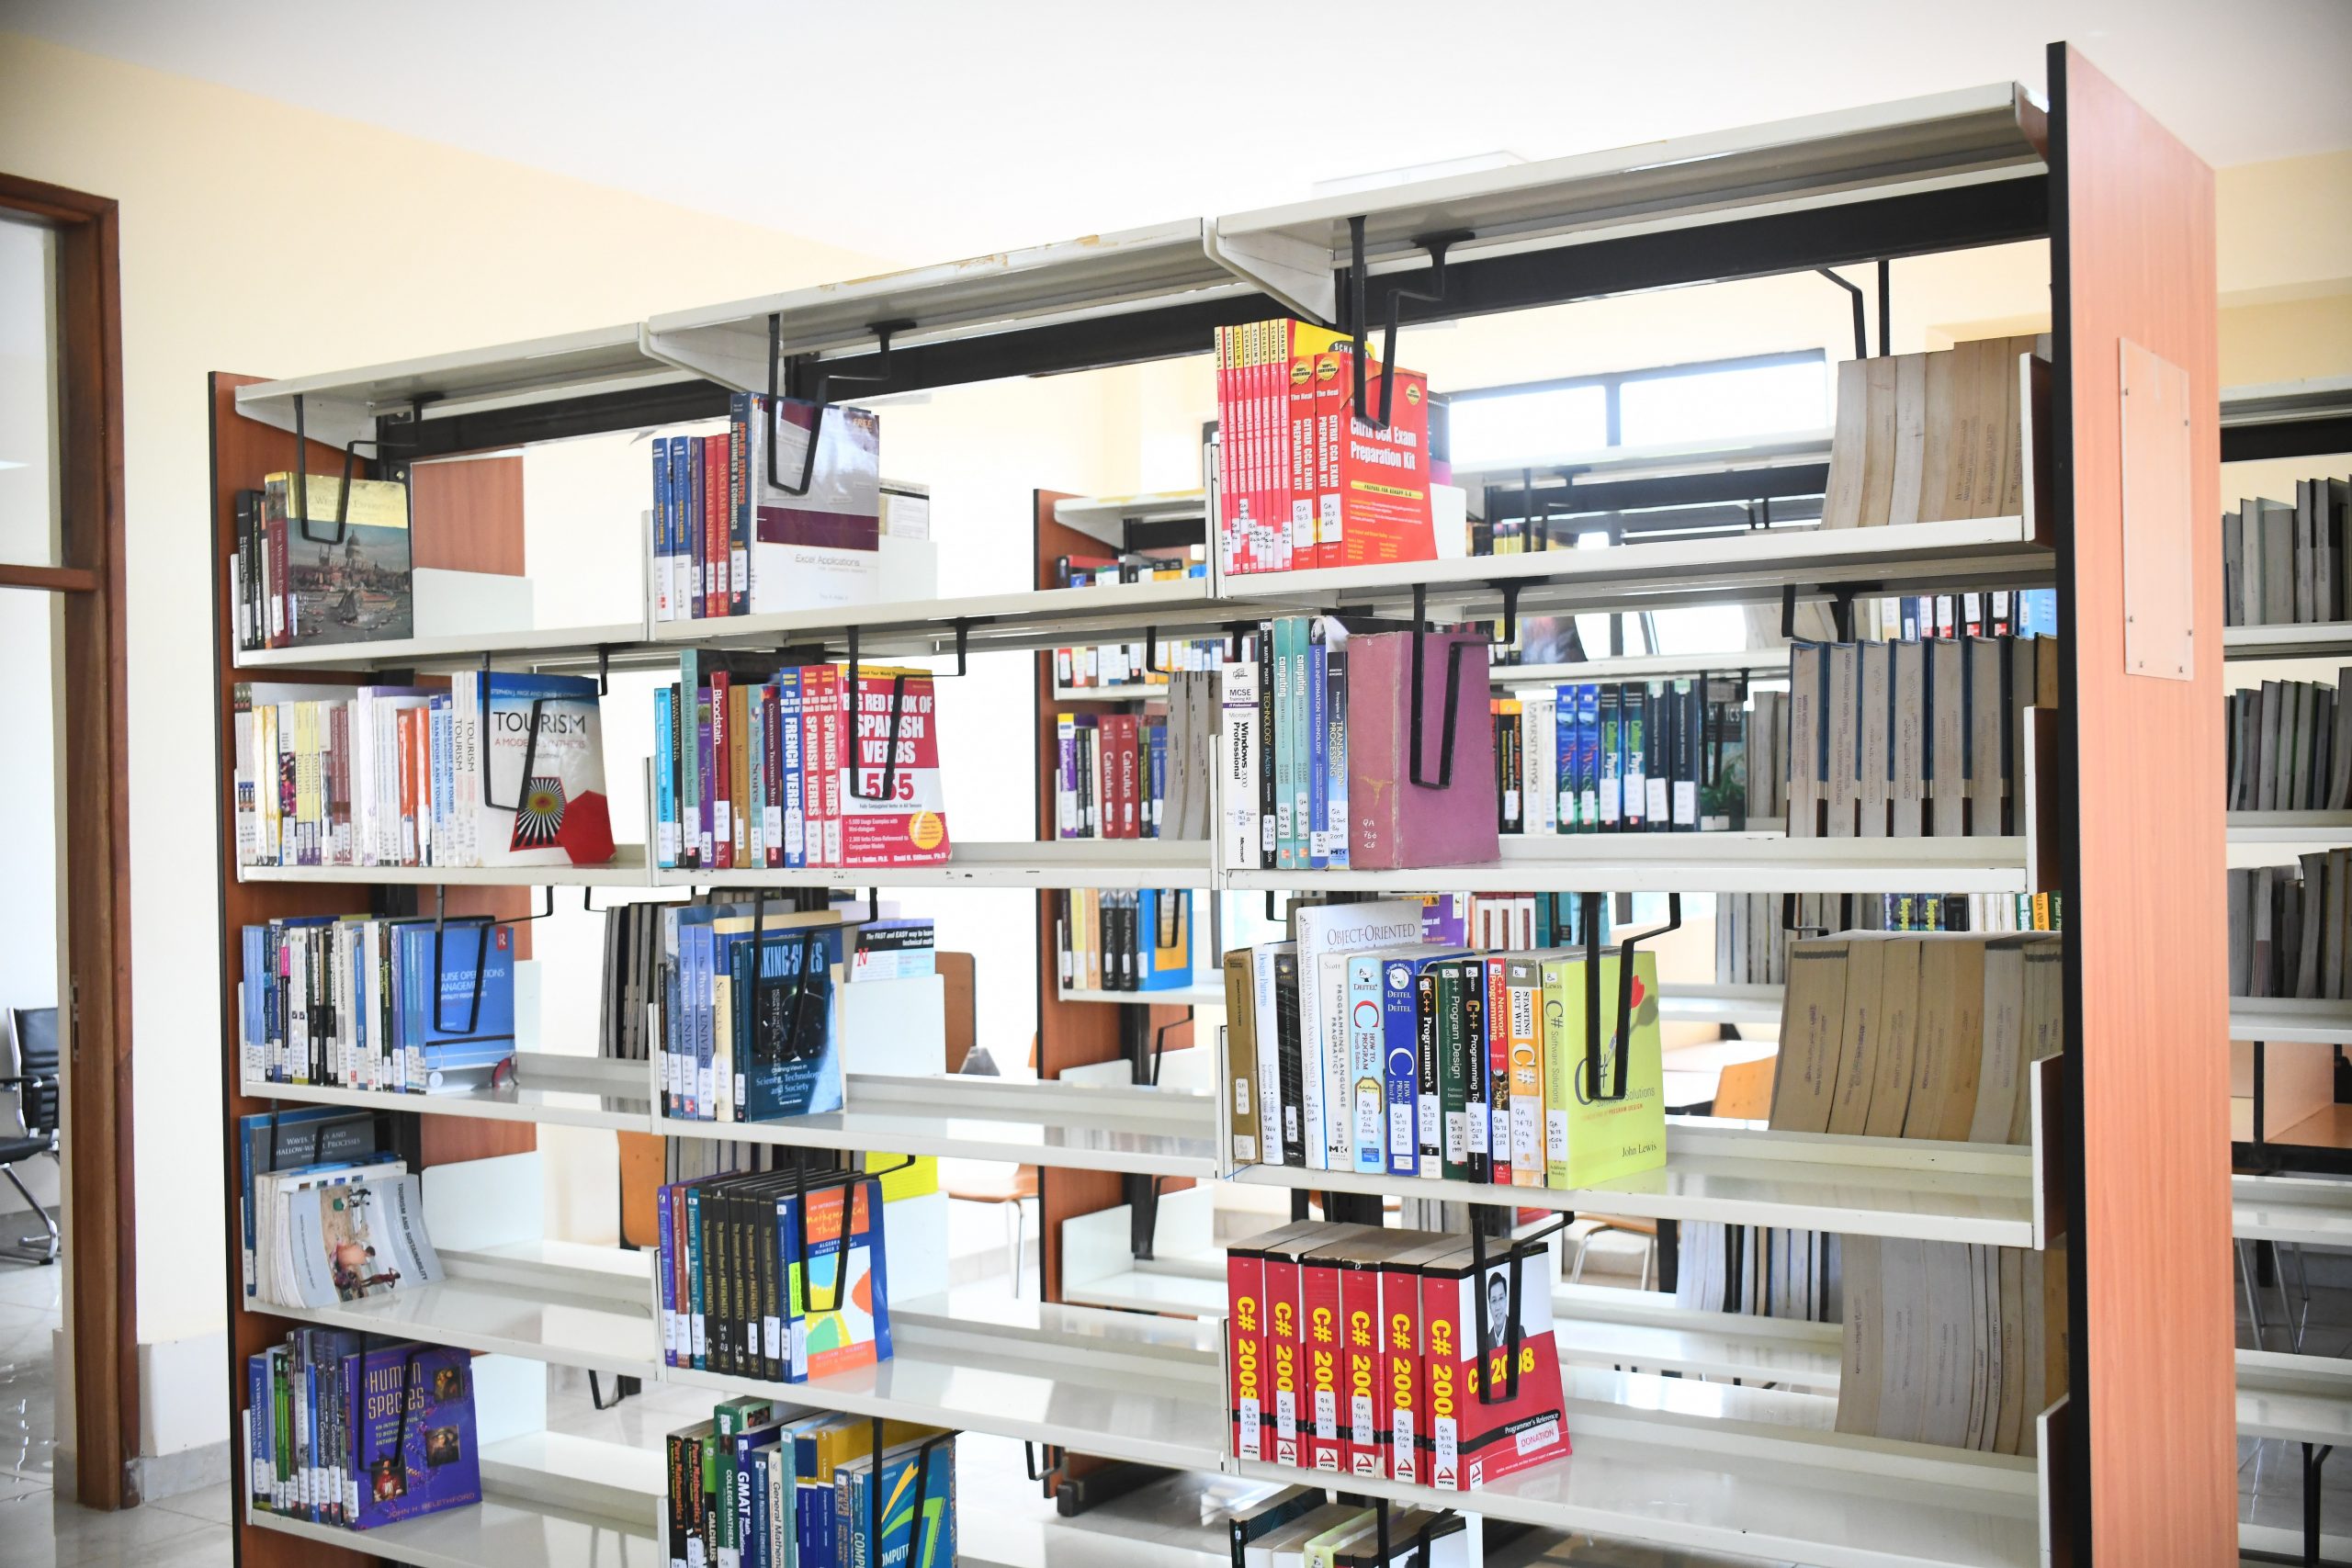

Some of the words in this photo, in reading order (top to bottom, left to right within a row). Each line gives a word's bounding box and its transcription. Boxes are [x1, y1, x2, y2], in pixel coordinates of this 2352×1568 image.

[853, 417, 873, 428] FREE
[1304, 418, 1312, 446] CITRIX
[1329, 415, 1338, 442] CITRIX
[1394, 426, 1417, 447] Exam
[1293, 420, 1302, 475] PREPARATION
[1304, 448, 1312, 465] CCA
[1319, 416, 1328, 472] PREPARATION
[1329, 445, 1338, 462] CCA
[1351, 441, 1402, 468] Preparation
[1403, 451, 1416, 470] Kit
[1294, 477, 1302, 491] KIT
[1304, 467, 1313, 491] EXAM
[1330, 464, 1339, 487] EXAM
[1278, 656, 1288, 697] computing
[1296, 654, 1306, 695] computing
[714, 689, 724, 745] Bloodstain
[865, 694, 886, 712] RED
[919, 696, 932, 713] OF
[493, 711, 585, 734] TOURISM
[785, 717, 798, 768] FRENCH
[806, 716, 818, 771] SPANISH
[824, 715, 836, 770] SPANISH
[1104, 751, 1114, 799] Calculus
[1123, 750, 1133, 798] Calculus
[808, 774, 819, 817] VERBS
[826, 774, 836, 816] VERBS
[1327, 923, 1415, 946] OBJECT-ORIENTED
[1354, 1000, 1380, 1028] C
[1450, 996, 1460, 1040] Program
[1466, 1000, 1480, 1030] C++
[1488, 976, 1497, 1041] Programming
[1545, 1000, 1564, 1028] C#
[1370, 1052, 1376, 1063] TO
[1389, 1048, 1414, 1076] C
[1422, 1017, 1433, 1089] Programmer's
[1453, 1043, 1461, 1078] Design
[1512, 1043, 1536, 1085] C#
[1625, 1088, 1655, 1101] Solutions
[1622, 1146, 1637, 1157] John
[1639, 1140, 1657, 1154] Lewis
[397, 1183, 407, 1214] TOURISM
[1237, 1296, 1256, 1331] C#
[1275, 1302, 1292, 1337] C#
[1313, 1307, 1331, 1343] C#
[1351, 1311, 1371, 1347] C#
[1392, 1314, 1411, 1350] C#
[1431, 1320, 1452, 1356] C#
[1505, 1419, 1536, 1434] Programmer's
[1536, 1413, 1559, 1424] Reference
[1521, 1428, 1555, 1447] DONATION
[737, 1471, 751, 1517] GMAT
[708, 1511, 717, 1562] CALCULUS
